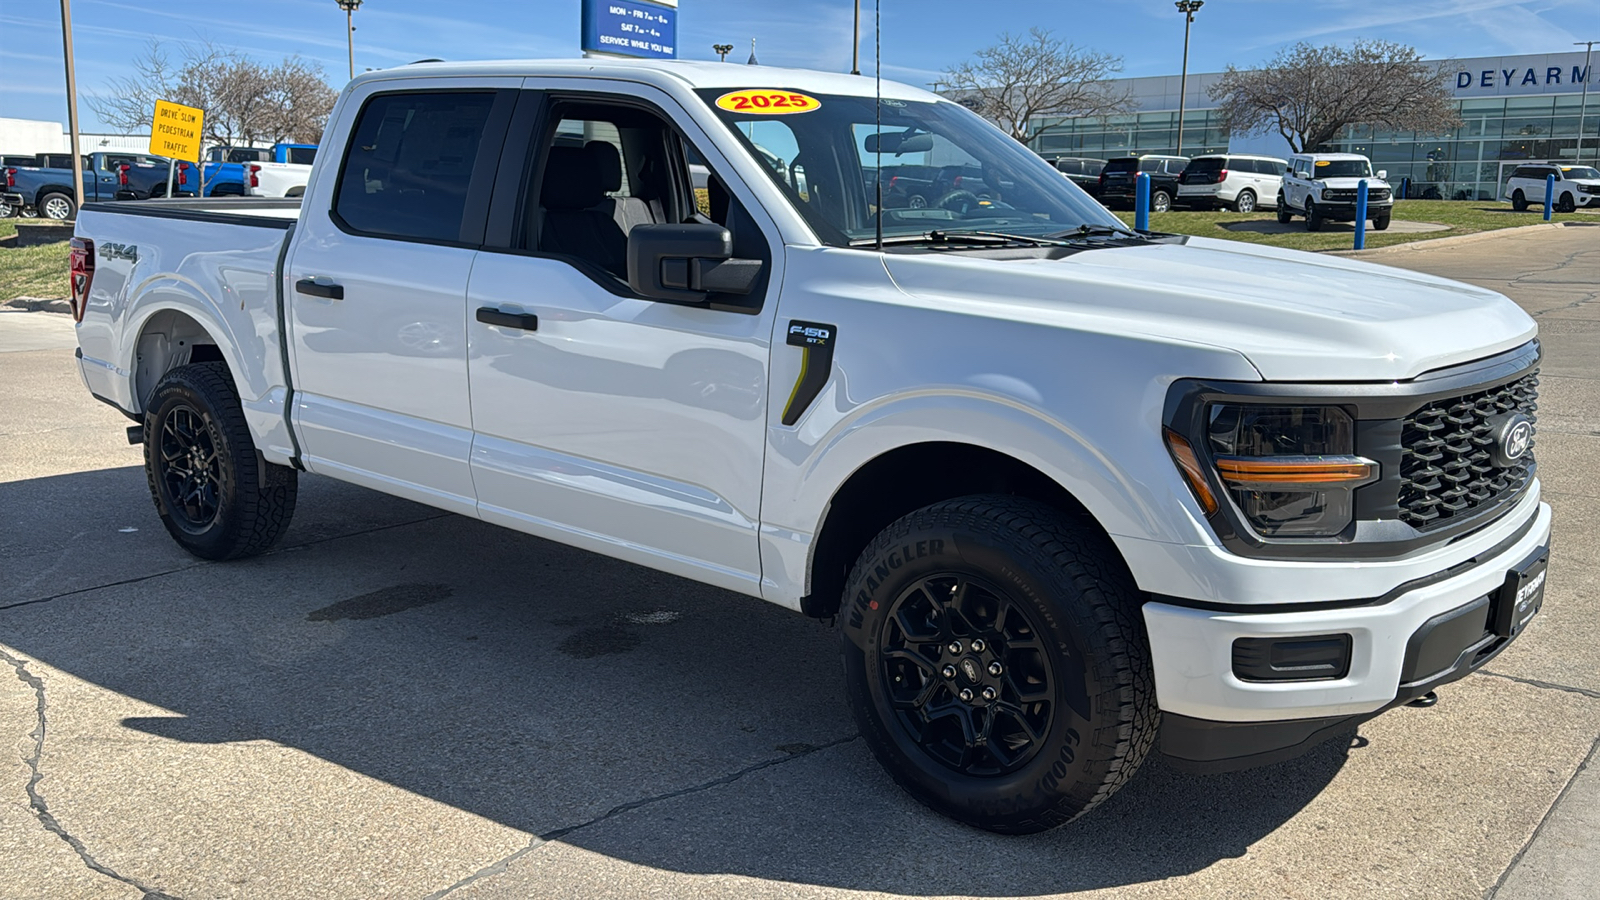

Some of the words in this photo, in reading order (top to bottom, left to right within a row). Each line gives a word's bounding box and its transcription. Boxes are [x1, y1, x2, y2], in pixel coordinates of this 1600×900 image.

[609, 6, 626, 15] MON
[633, 9, 643, 18] FRI
[621, 23, 633, 32] SAT
[600, 35, 629, 46] SERVICE
[631, 40, 649, 49] WHILE
[651, 43, 661, 52] YOU
[1457, 65, 1600, 89] DEYARM
[730, 94, 809, 110] 2025
[160, 108, 178, 120] DRIVE
[181, 112, 196, 123] SLOW
[158, 123, 194, 139] PEDESTRIAN
[163, 140, 188, 153] TRAFFIC
[789, 325, 830, 339] F-150
[806, 337, 825, 345] STX
[1509, 424, 1530, 456] Ford
[849, 538, 945, 630] WRANGLER
